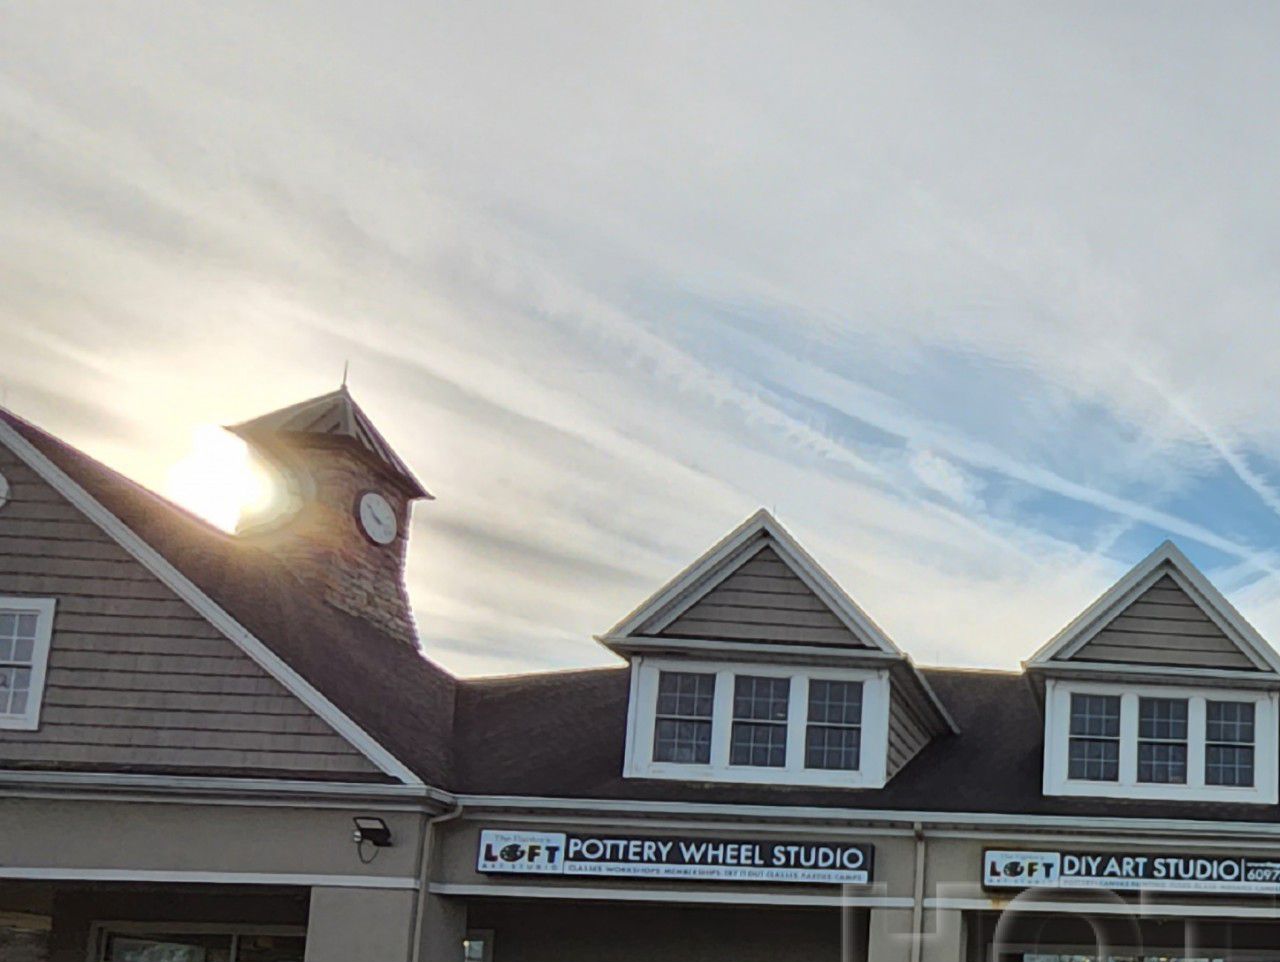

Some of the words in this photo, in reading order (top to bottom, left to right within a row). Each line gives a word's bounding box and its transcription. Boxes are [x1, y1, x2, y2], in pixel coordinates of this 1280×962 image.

[484, 844, 559, 863] LOFT
[568, 838, 673, 861] POTTERY
[680, 841, 764, 865] WHEEL
[772, 845, 864, 869] STUDIO
[990, 861, 1054, 878] LOFT
[1063, 855, 1102, 875] DIY
[1103, 857, 1148, 877] ART
[1153, 858, 1240, 880] STUDIO
